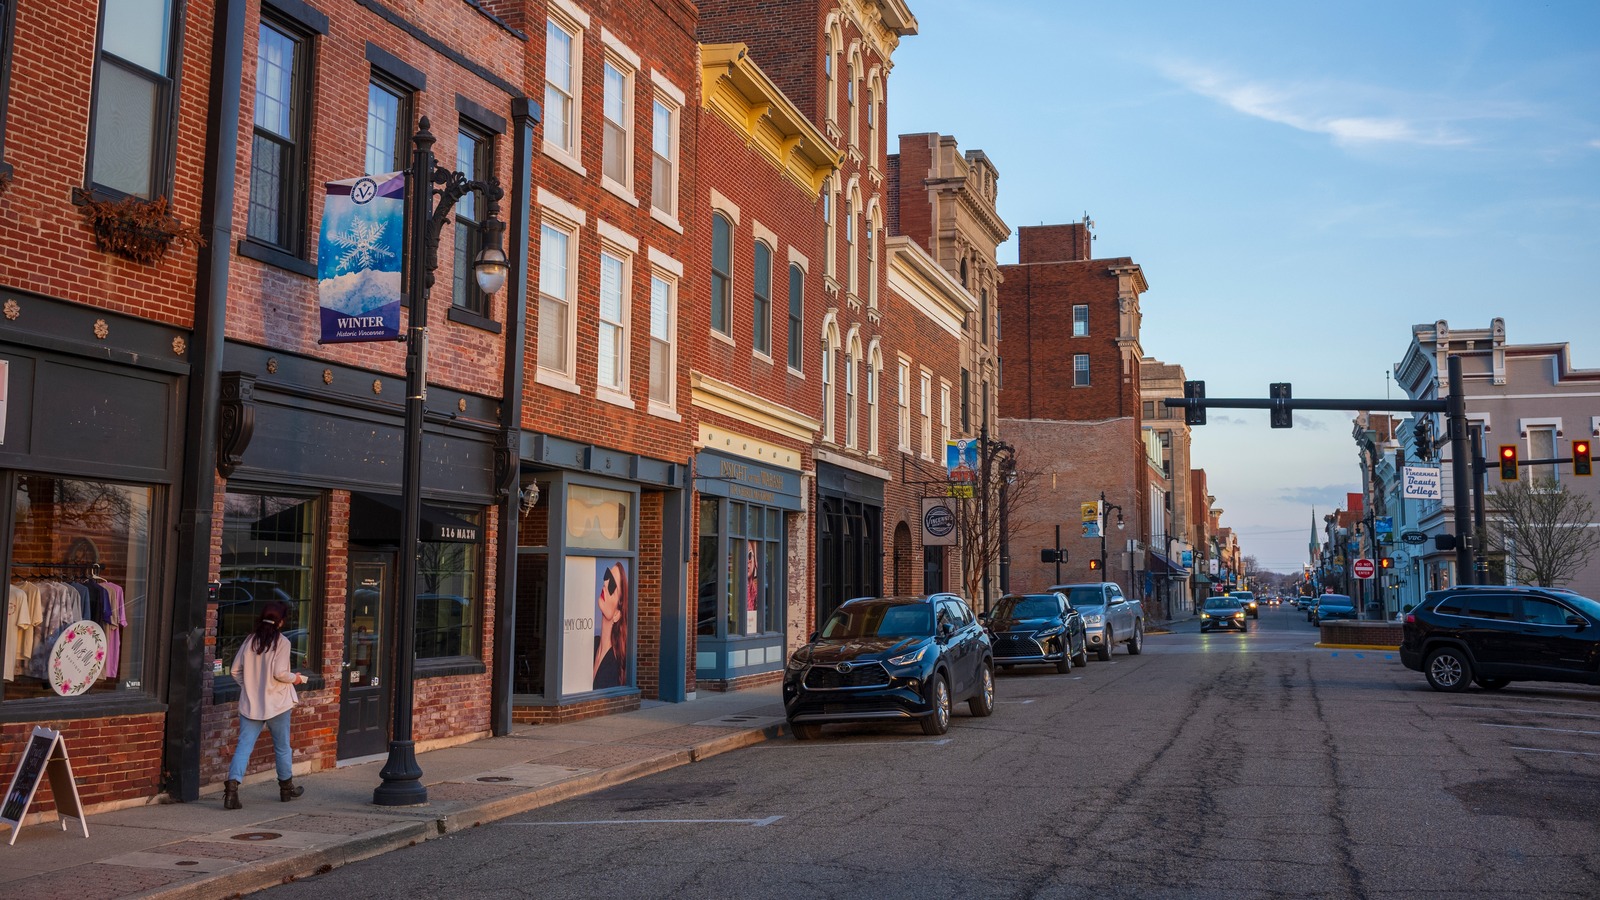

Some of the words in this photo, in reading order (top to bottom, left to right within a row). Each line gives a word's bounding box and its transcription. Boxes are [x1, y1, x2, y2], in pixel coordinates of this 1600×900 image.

[358, 186, 371, 199] V
[337, 316, 384, 329] WINTER
[720, 460, 747, 481] INSIGHT
[1407, 476, 1437, 488] Beauty
[1406, 485, 1439, 497] College
[441, 527, 455, 538] 116
[456, 528, 476, 539] MAIN
[575, 617, 593, 630] CHOO
